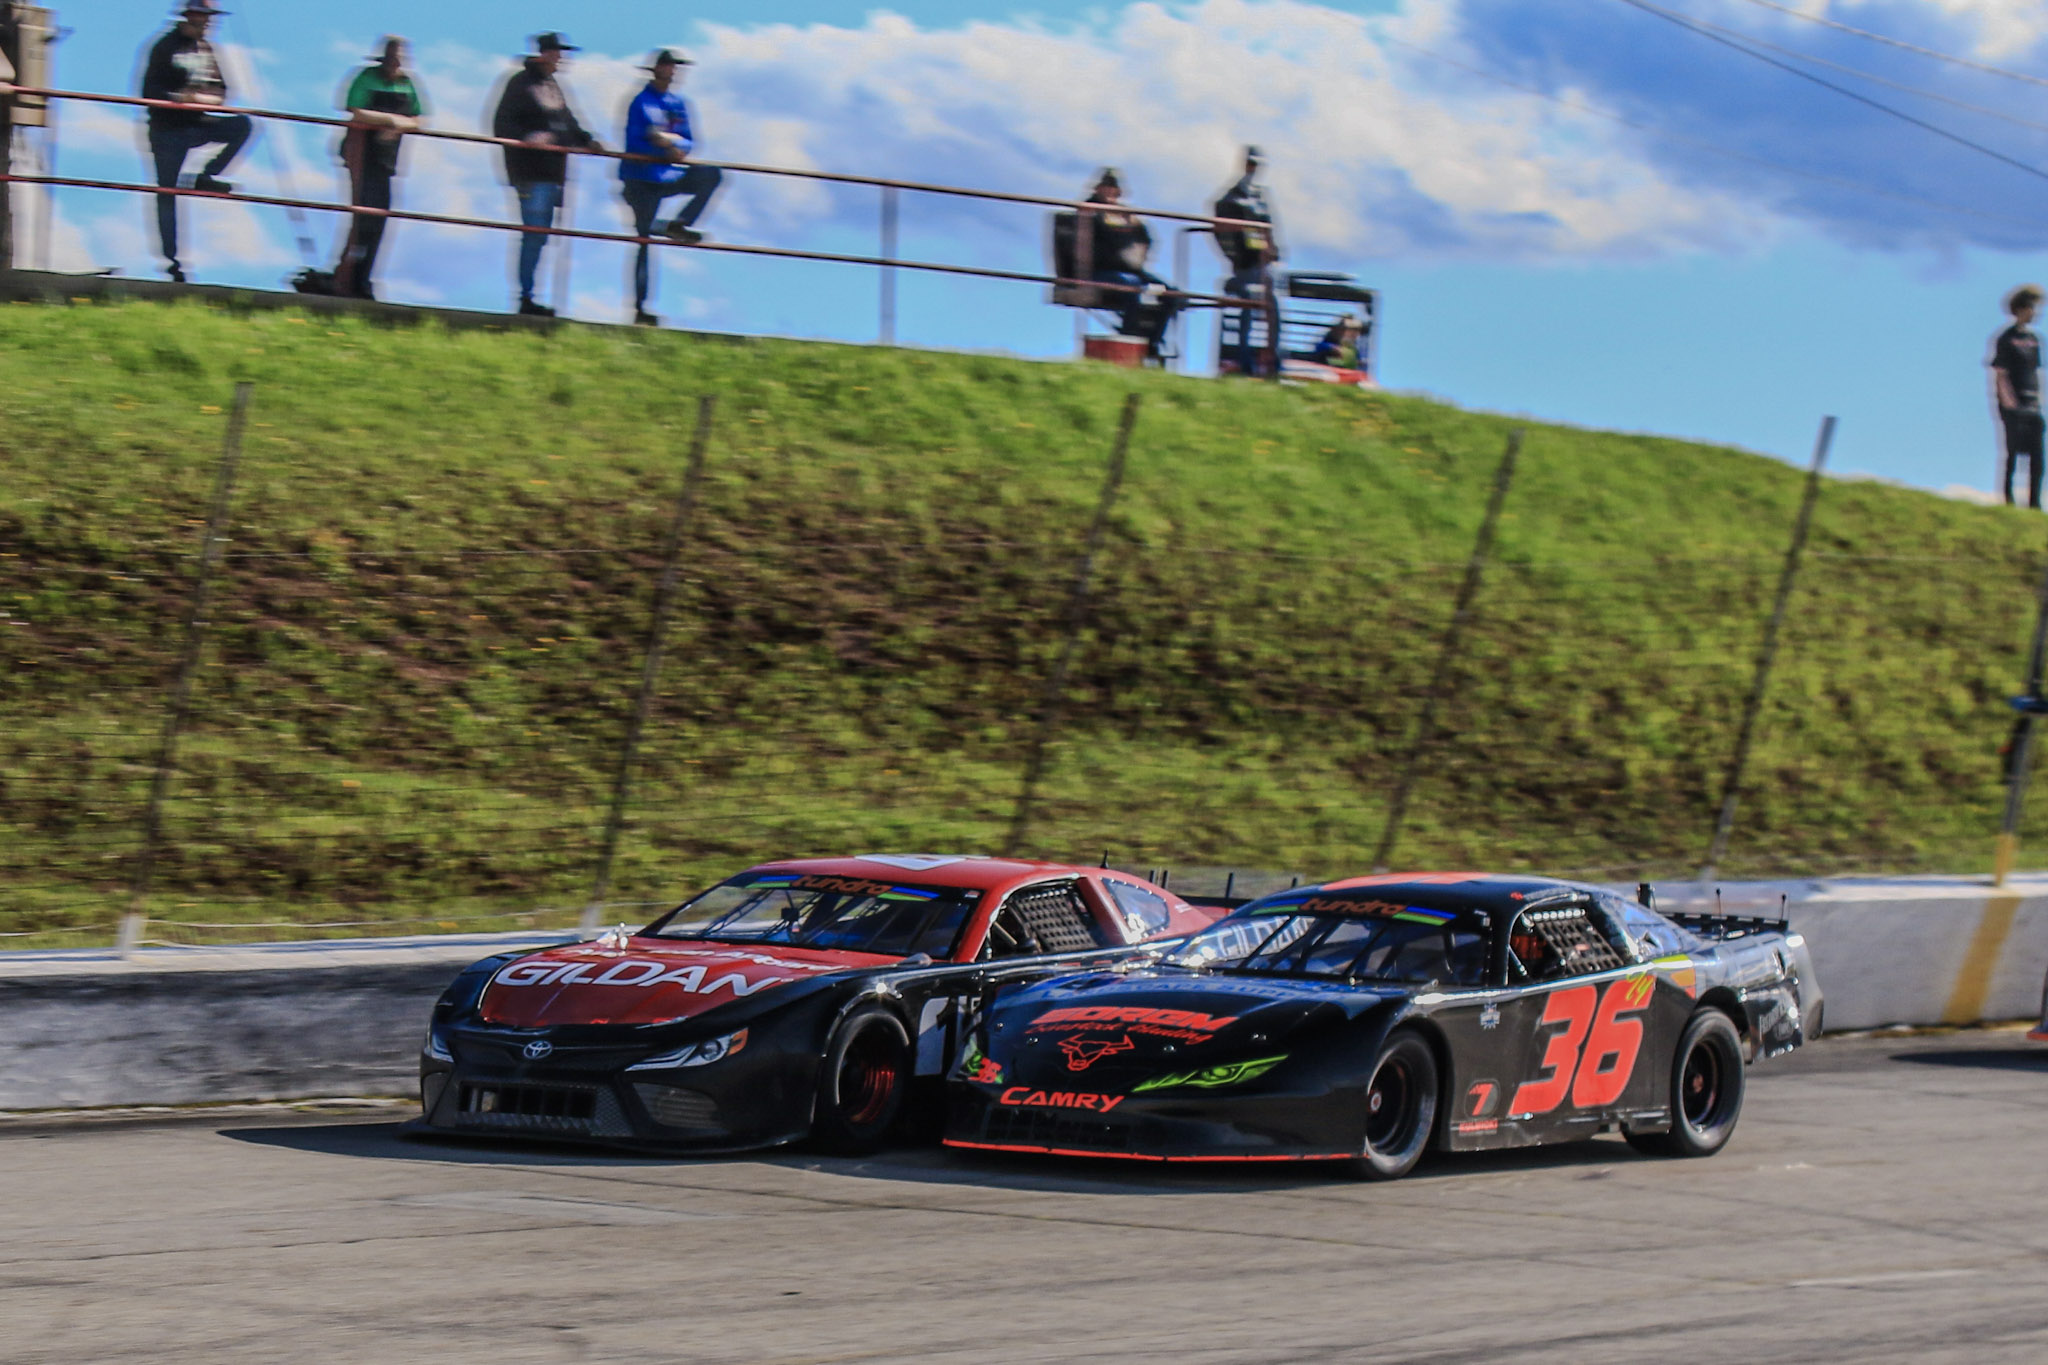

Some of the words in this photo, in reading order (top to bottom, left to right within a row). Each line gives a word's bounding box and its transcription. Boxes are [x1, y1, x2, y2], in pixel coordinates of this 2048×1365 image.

[791, 875, 893, 895] tundra
[1299, 898, 1408, 915] tundra
[495, 961, 781, 996] GILDAN
[1506, 974, 1657, 1117] 36
[999, 1086, 1125, 1113] CAMRY
[1468, 1083, 1493, 1116] 7
